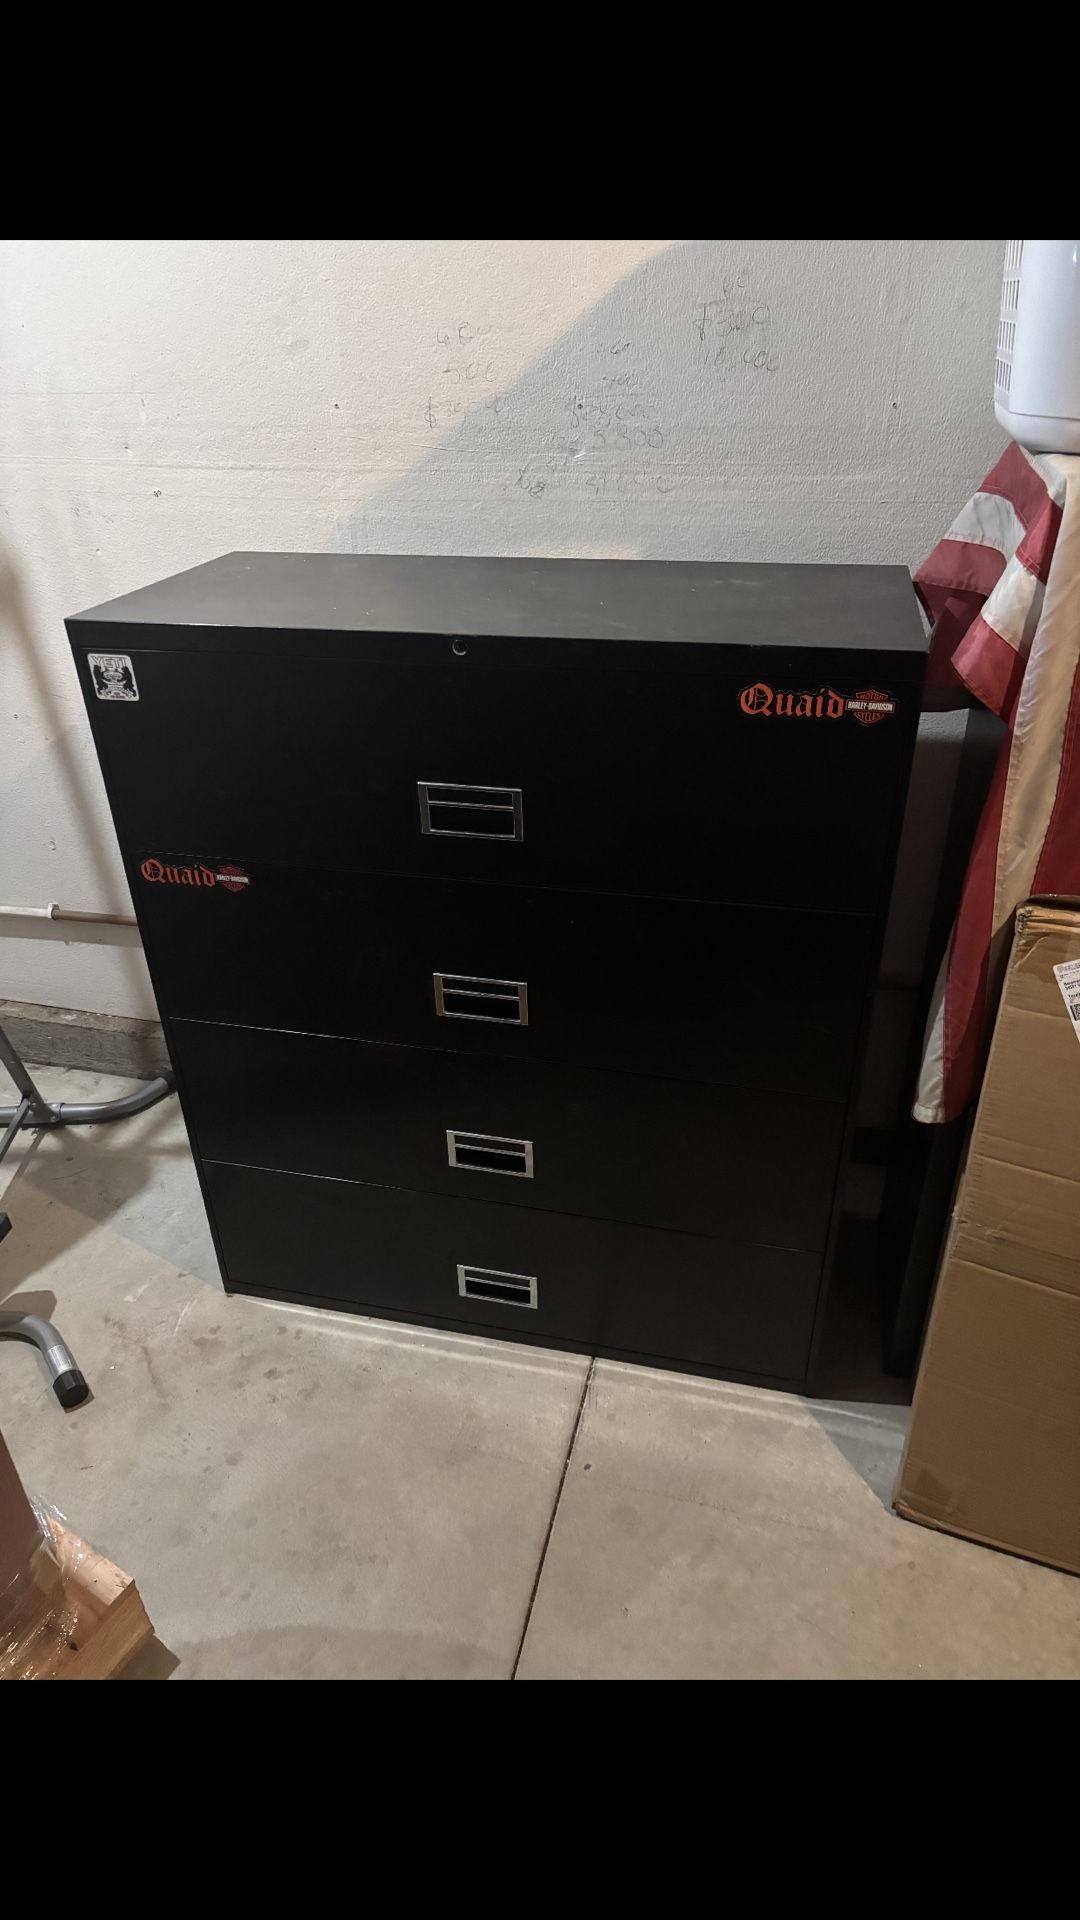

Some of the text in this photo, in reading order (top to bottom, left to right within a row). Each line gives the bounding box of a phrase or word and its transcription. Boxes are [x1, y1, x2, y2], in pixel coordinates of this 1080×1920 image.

[90, 655, 127, 669] YETI
[740, 682, 845, 718] Quaid
[847, 701, 893, 711] HARLEY-DAVIDSON
[141, 858, 216, 887] Quaid
